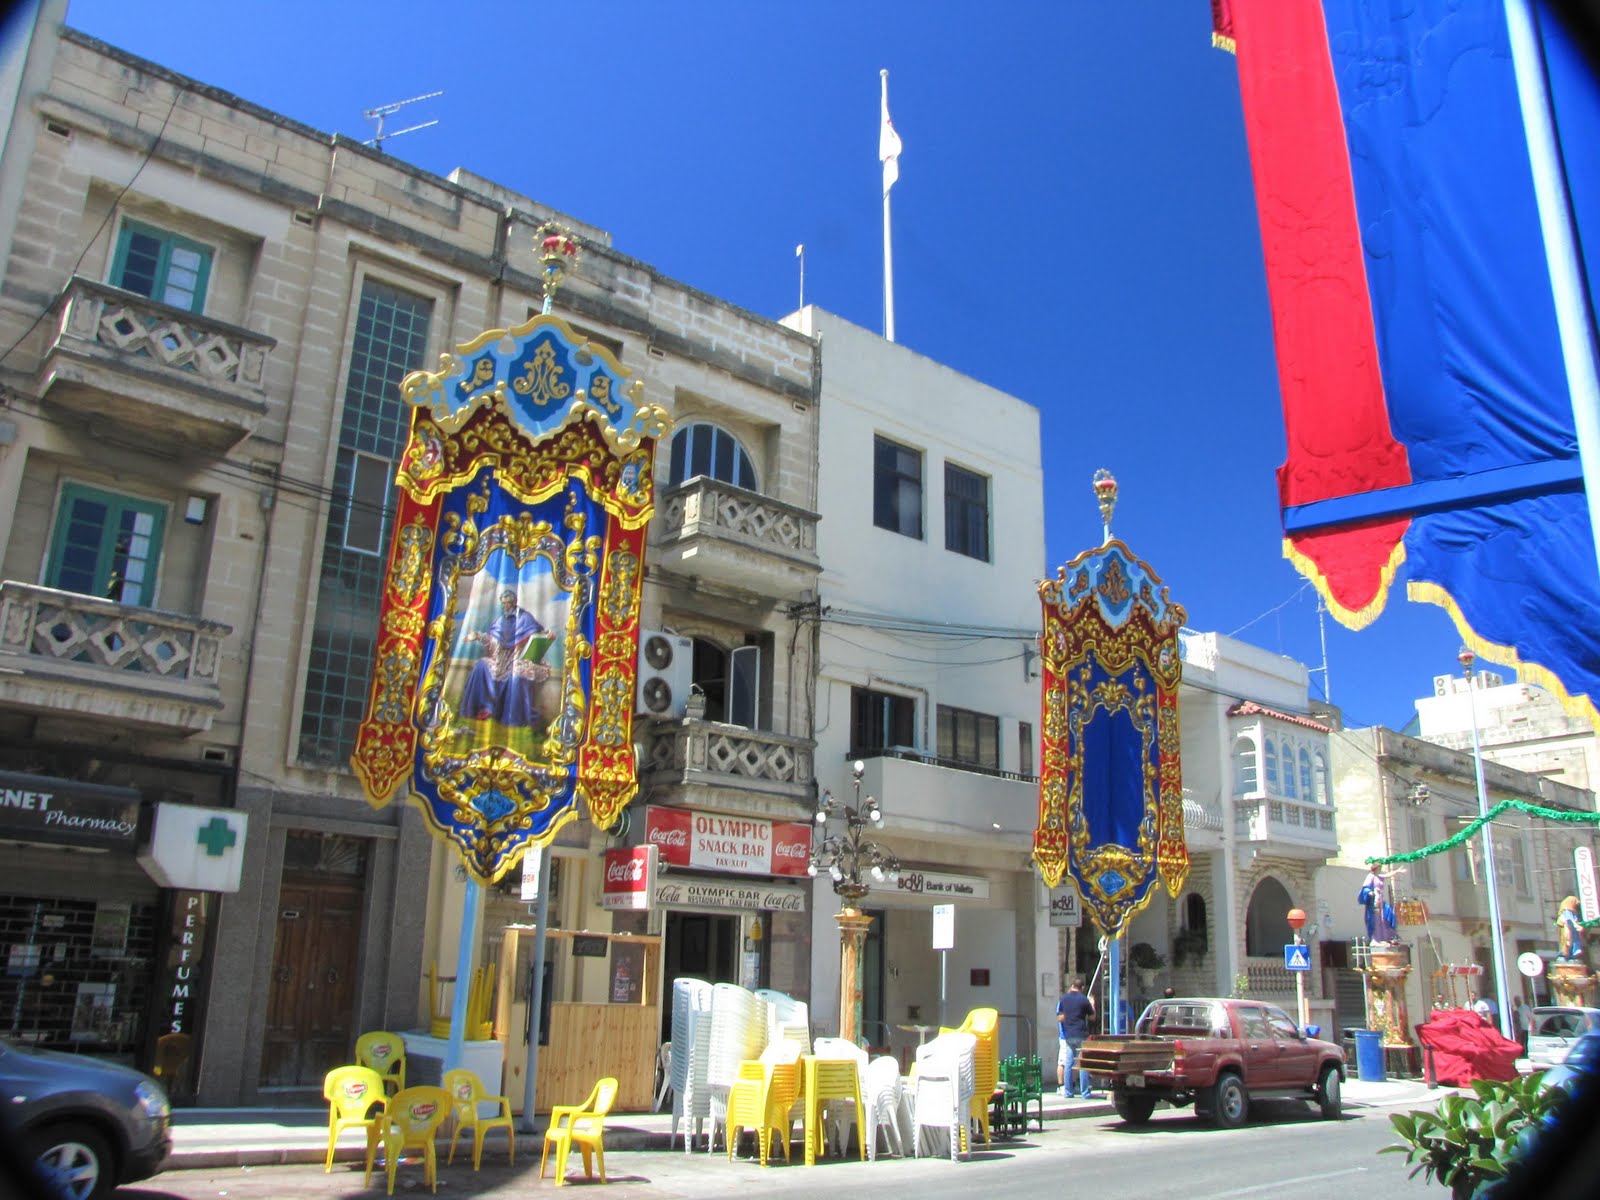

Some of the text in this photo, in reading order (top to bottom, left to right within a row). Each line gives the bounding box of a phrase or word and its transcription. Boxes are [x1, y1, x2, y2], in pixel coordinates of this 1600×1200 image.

[45, 810, 136, 835] Pharmacy
[696, 816, 769, 840] OLYMPIC
[698, 839, 765, 857] SNACK BAR
[688, 886, 760, 900] OLYMPIC BAR
[926, 881, 943, 891] Bank
[171, 897, 198, 1033] PERFUMES
